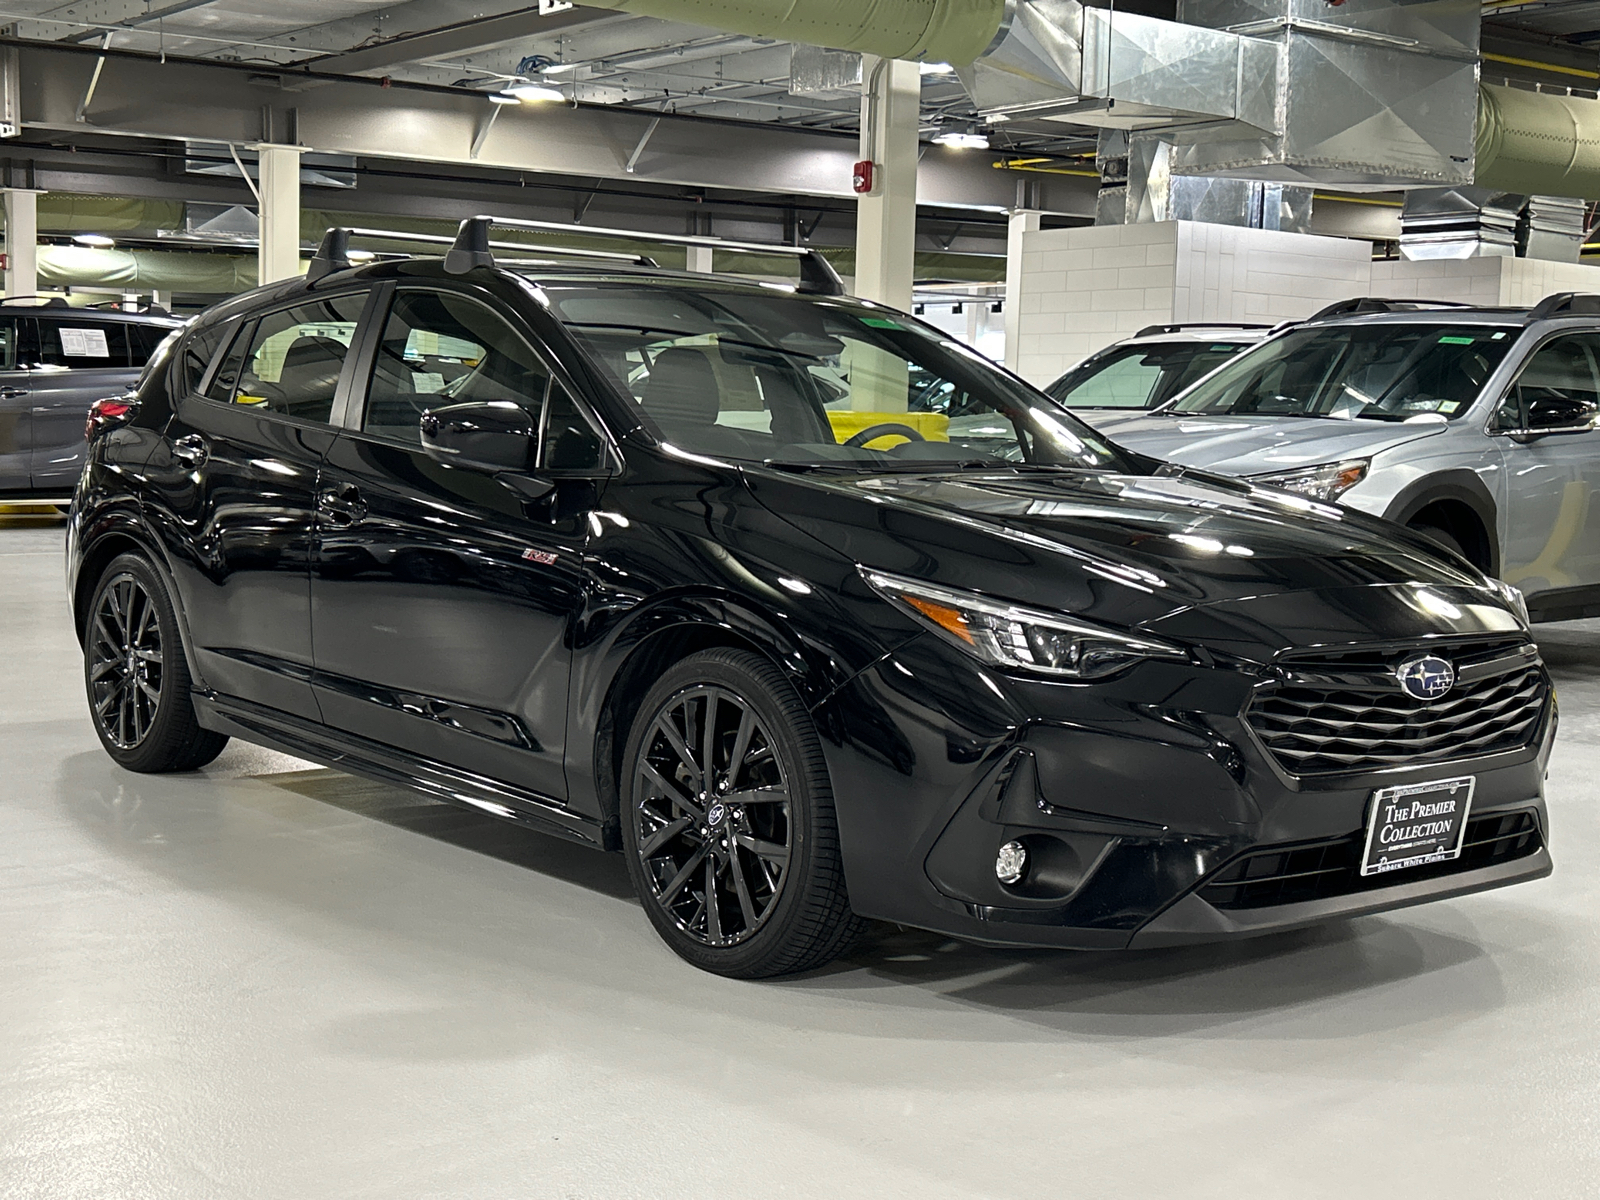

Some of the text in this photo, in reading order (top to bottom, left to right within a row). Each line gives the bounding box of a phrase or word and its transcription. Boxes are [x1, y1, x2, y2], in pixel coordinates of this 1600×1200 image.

[1385, 800, 1456, 823] THE PREMIER
[1380, 819, 1453, 844] COLLECTION
[1378, 854, 1445, 872] Subaru White Plains
